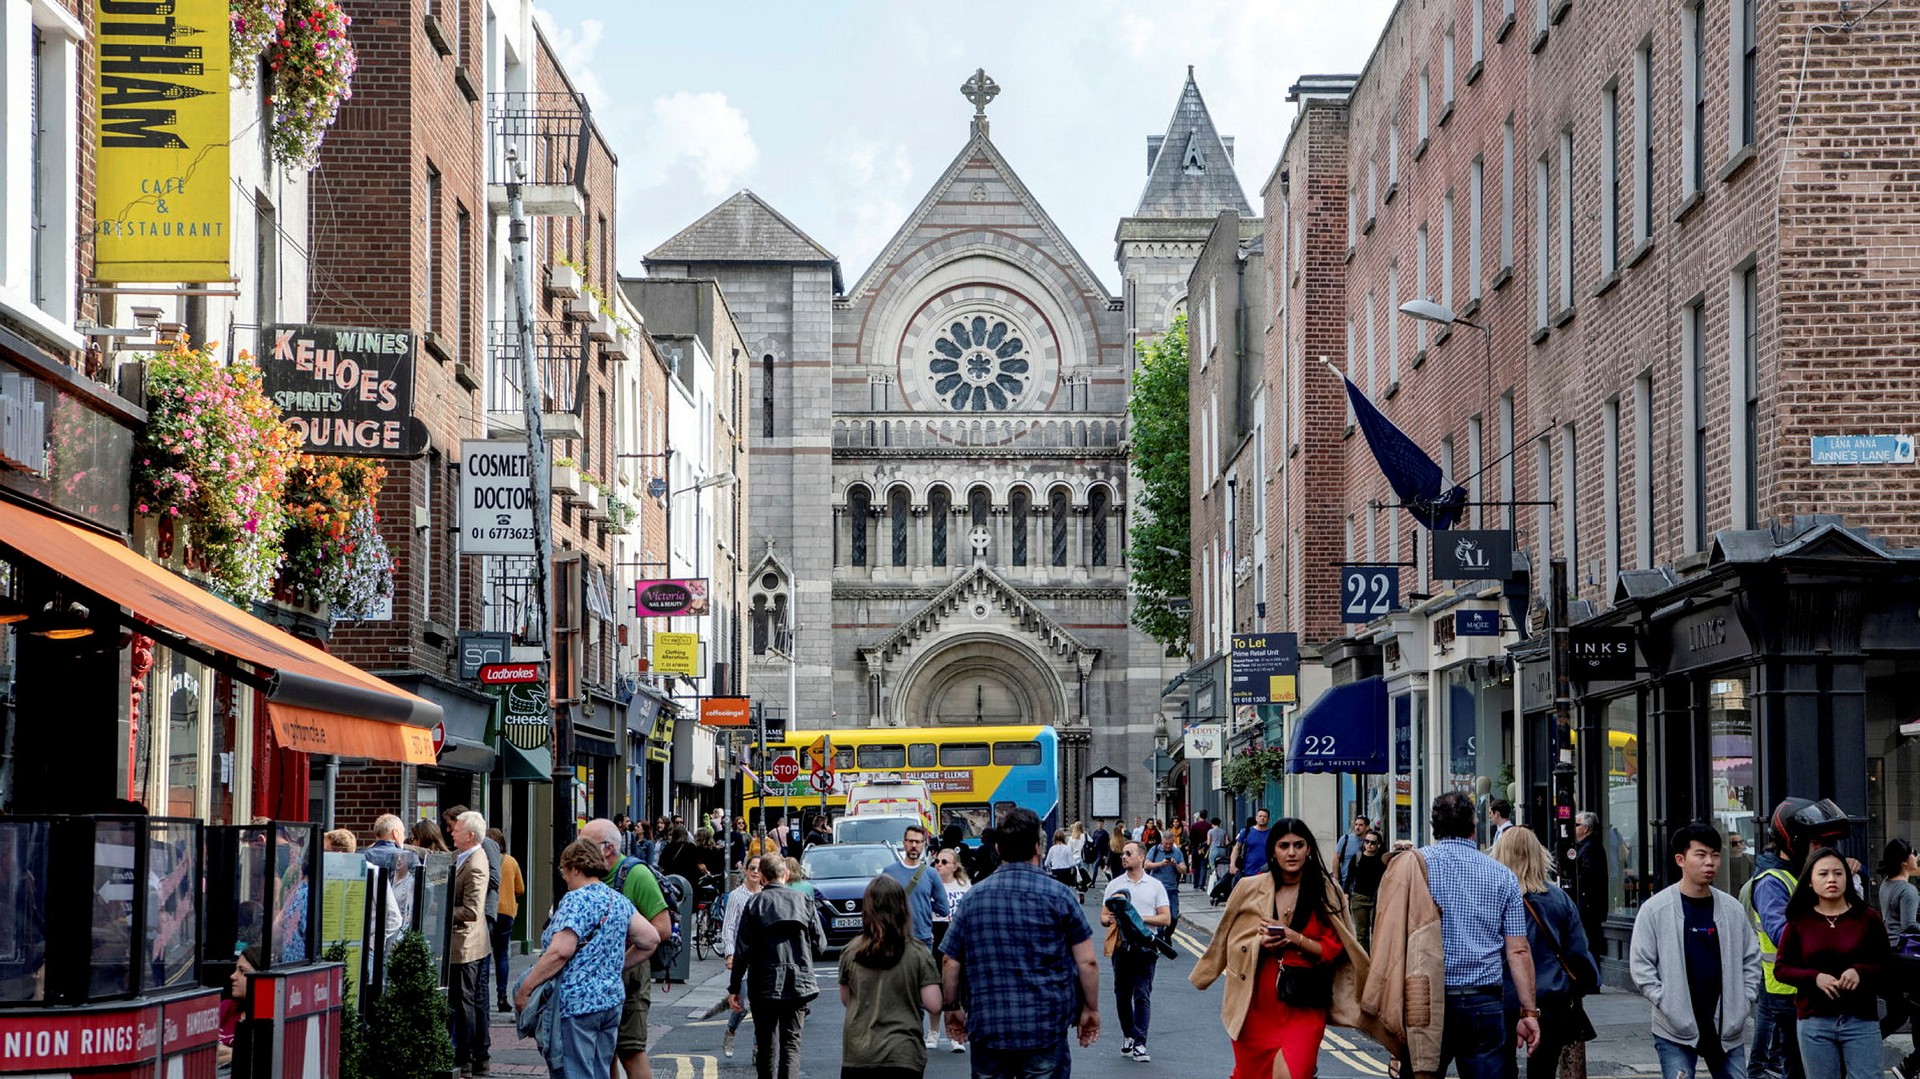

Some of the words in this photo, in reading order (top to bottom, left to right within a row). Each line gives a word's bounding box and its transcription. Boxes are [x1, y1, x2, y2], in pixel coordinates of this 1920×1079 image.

[156, 199, 169, 214] &
[103, 221, 223, 237] RESTAURANT
[336, 332, 409, 354] WINES
[274, 329, 397, 412] KEHOES
[274, 390, 342, 412] SPIRITS
[283, 416, 400, 449] OUNGE
[1854, 439, 1877, 449] ANNA
[1817, 450, 1858, 461] ANNE'S
[1862, 450, 1891, 461] LANE
[468, 454, 529, 477] COSMETI
[474, 487, 532, 510] DOCTOR
[471, 527, 484, 539] 01
[489, 527, 535, 540] 6773623
[647, 590, 685, 601] Victoria
[1346, 573, 1390, 614] 22
[1689, 617, 1726, 651] LINKS
[1232, 638, 1246, 649] To
[1248, 637, 1266, 648] Let
[1575, 642, 1628, 654] INKS
[465, 648, 502, 666] SO
[487, 668, 534, 680] Ladbrokes
[1271, 692, 1294, 701] savills
[1304, 735, 1336, 755] 22
[774, 764, 798, 775] STOP
[905, 771, 939, 780] GALLAGHER
[944, 771, 970, 779] ELLENOR
[772, 788, 785, 797] SEP
[788, 788, 797, 796] 27
[926, 782, 944, 790] KIELY
[80, 1025, 133, 1054] RINGS
